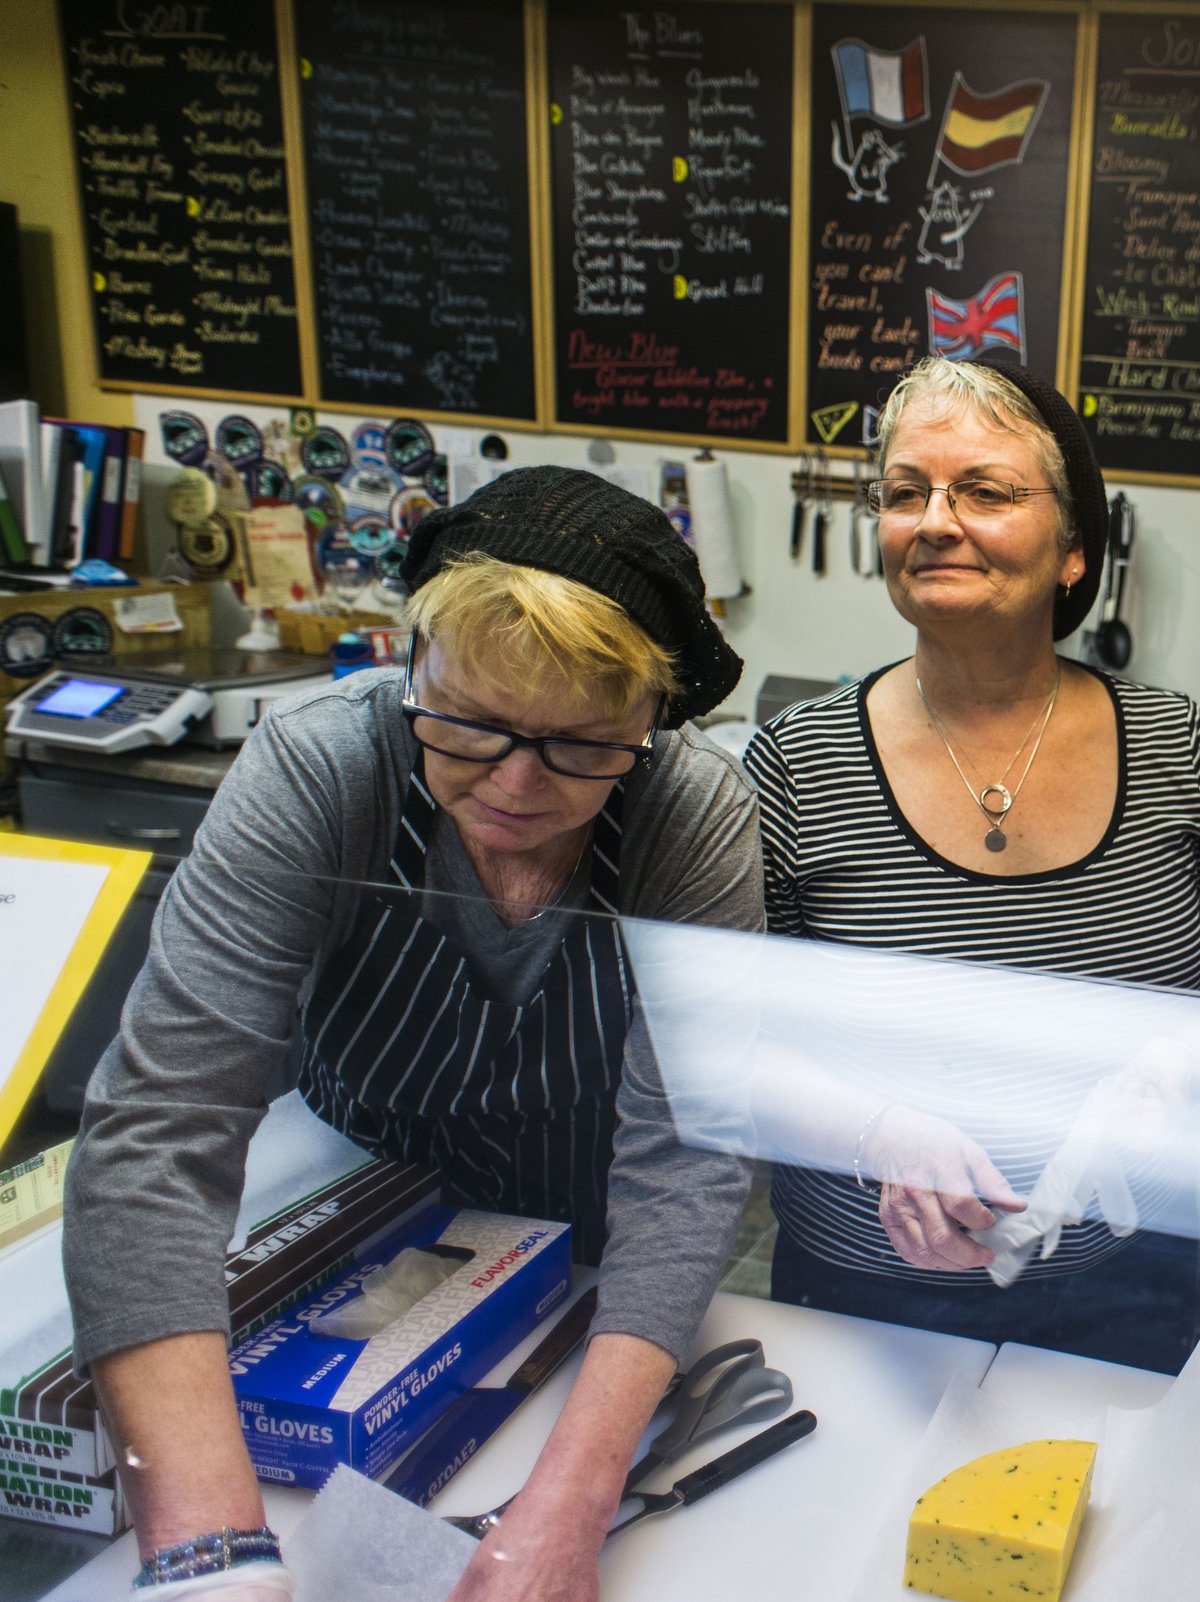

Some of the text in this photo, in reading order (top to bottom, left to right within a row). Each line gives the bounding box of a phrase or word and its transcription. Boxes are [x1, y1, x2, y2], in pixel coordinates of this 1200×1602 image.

[821, 220, 912, 253] Even if
[812, 262, 850, 289] you
[568, 328, 681, 362] New Blue
[1107, 362, 1168, 389] Hard
[240, 1200, 341, 1262] WRAP
[470, 1230, 550, 1289] FLAVORSEAL
[229, 1263, 385, 1376] VINYL GLOVES
[302, 1353, 348, 1390] MEDIUM
[363, 1367, 420, 1423] POWDER-FREE
[364, 1341, 463, 1437] VINYL GLOVES
[254, 1414, 335, 1446] GLOVES
[256, 1466, 292, 1480] EDIUM
[3, 1490, 91, 1519] WRAP
